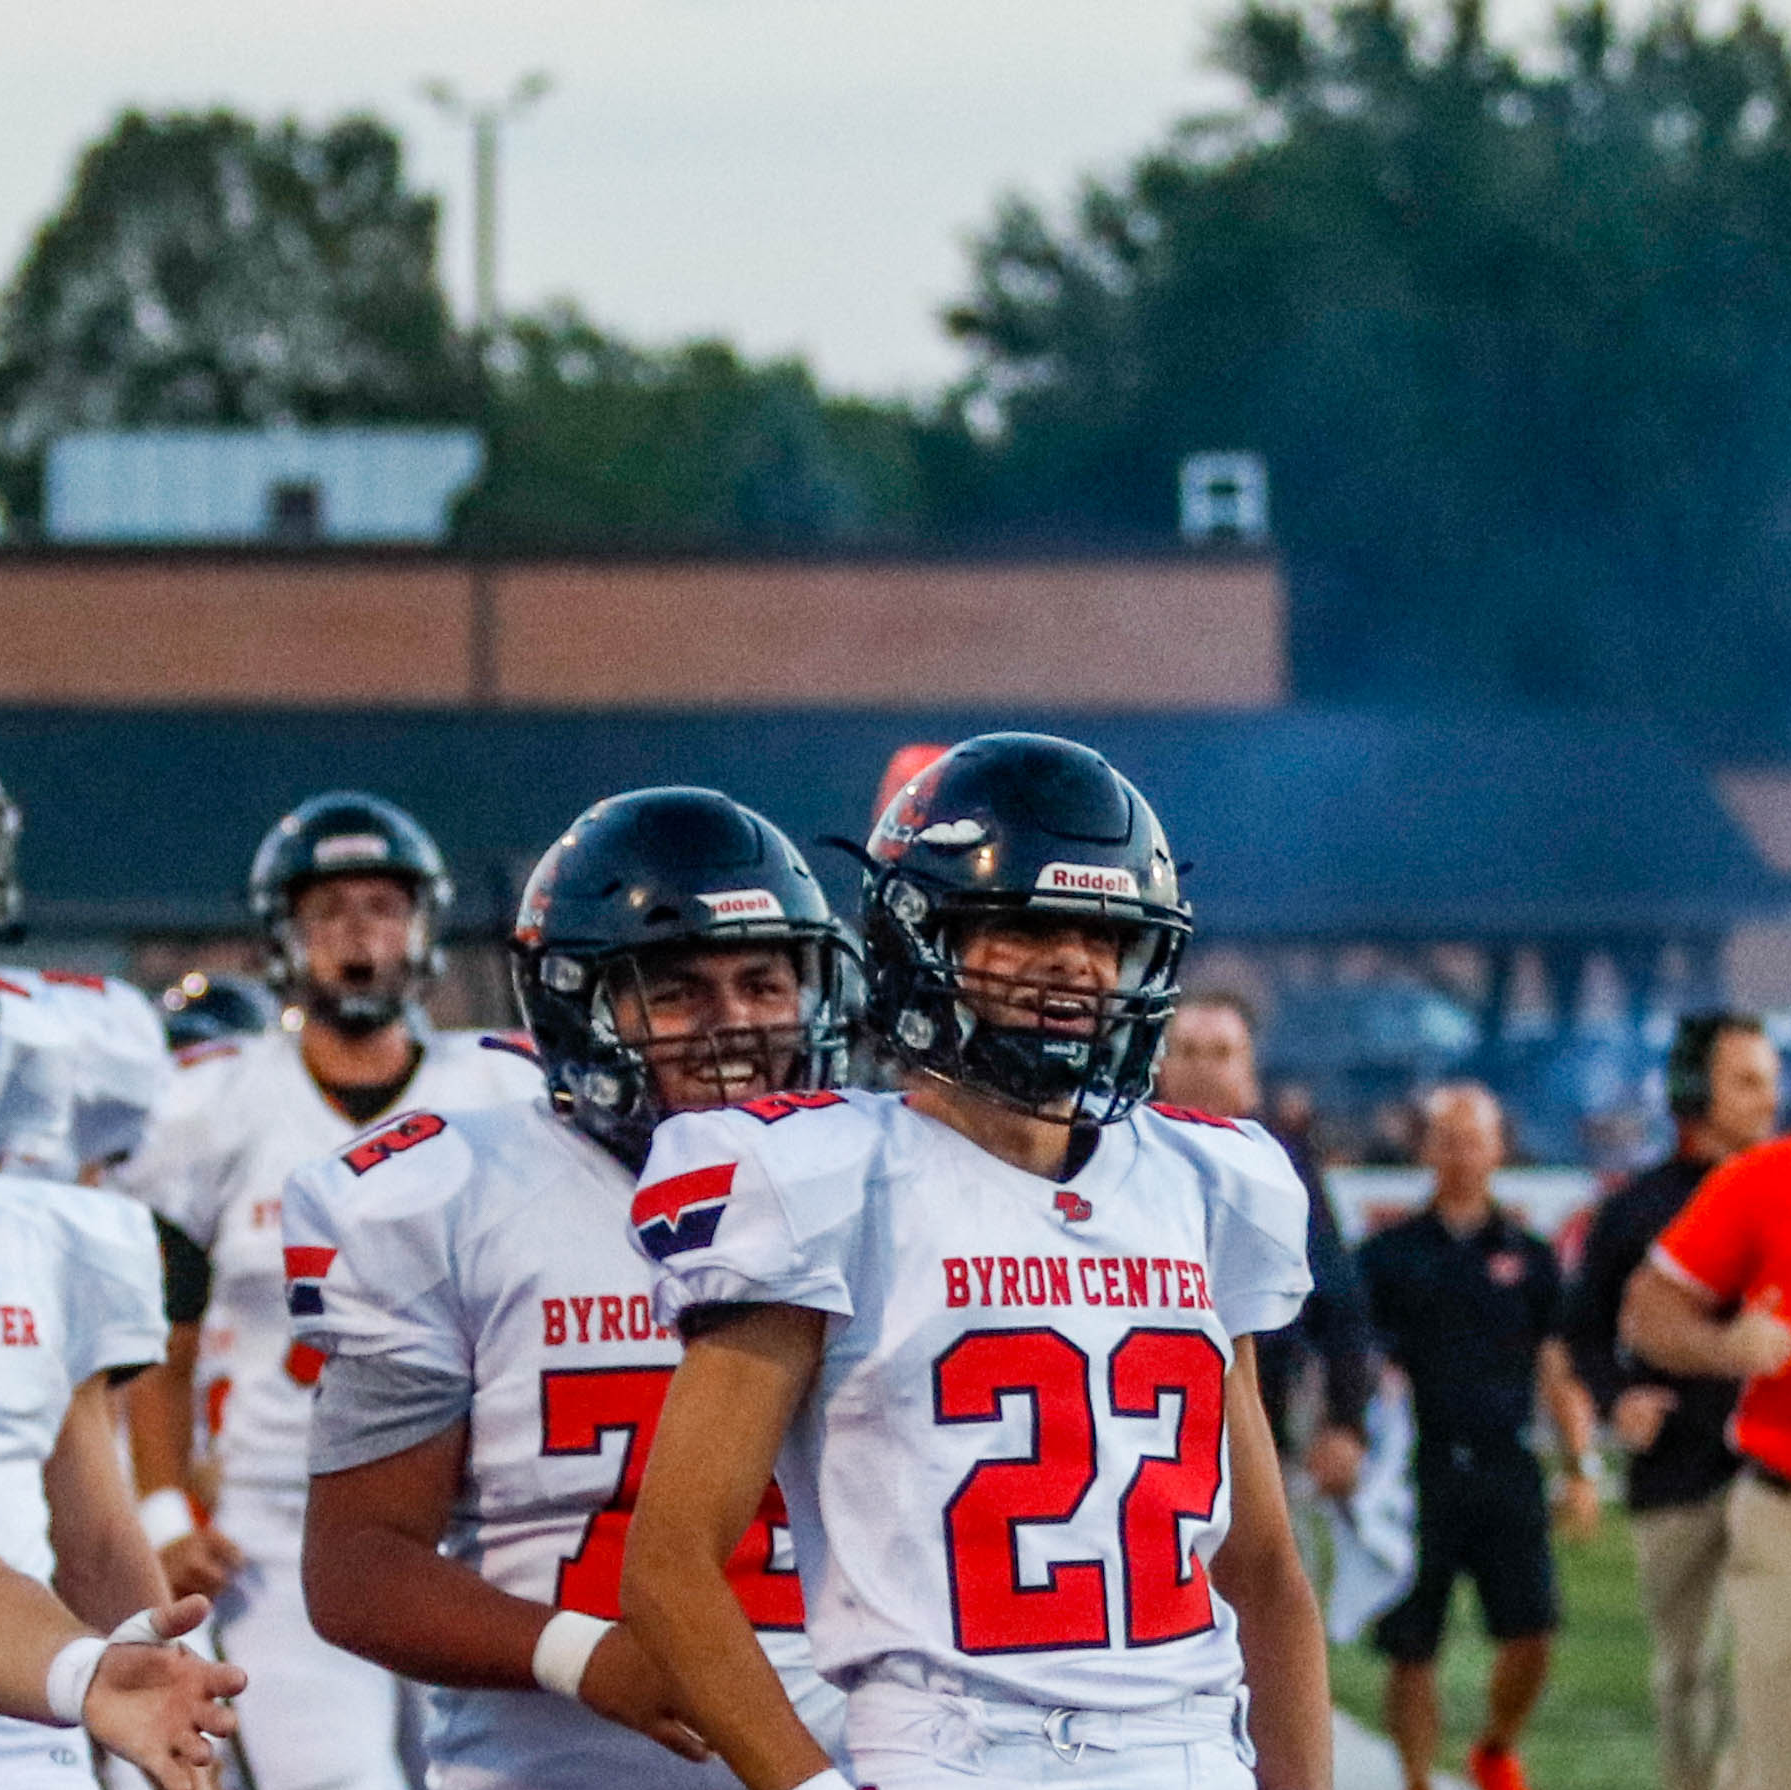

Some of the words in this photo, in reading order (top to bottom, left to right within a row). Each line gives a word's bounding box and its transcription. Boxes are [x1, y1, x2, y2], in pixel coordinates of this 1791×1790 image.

[711, 897, 770, 913] iddell
[1053, 870, 1129, 893] Riddell
[942, 1257, 1073, 1310] BYRON
[1079, 1257, 1215, 1310] CENTER
[542, 1295, 675, 1346] BYRO
[932, 1325, 1226, 1657] 22
